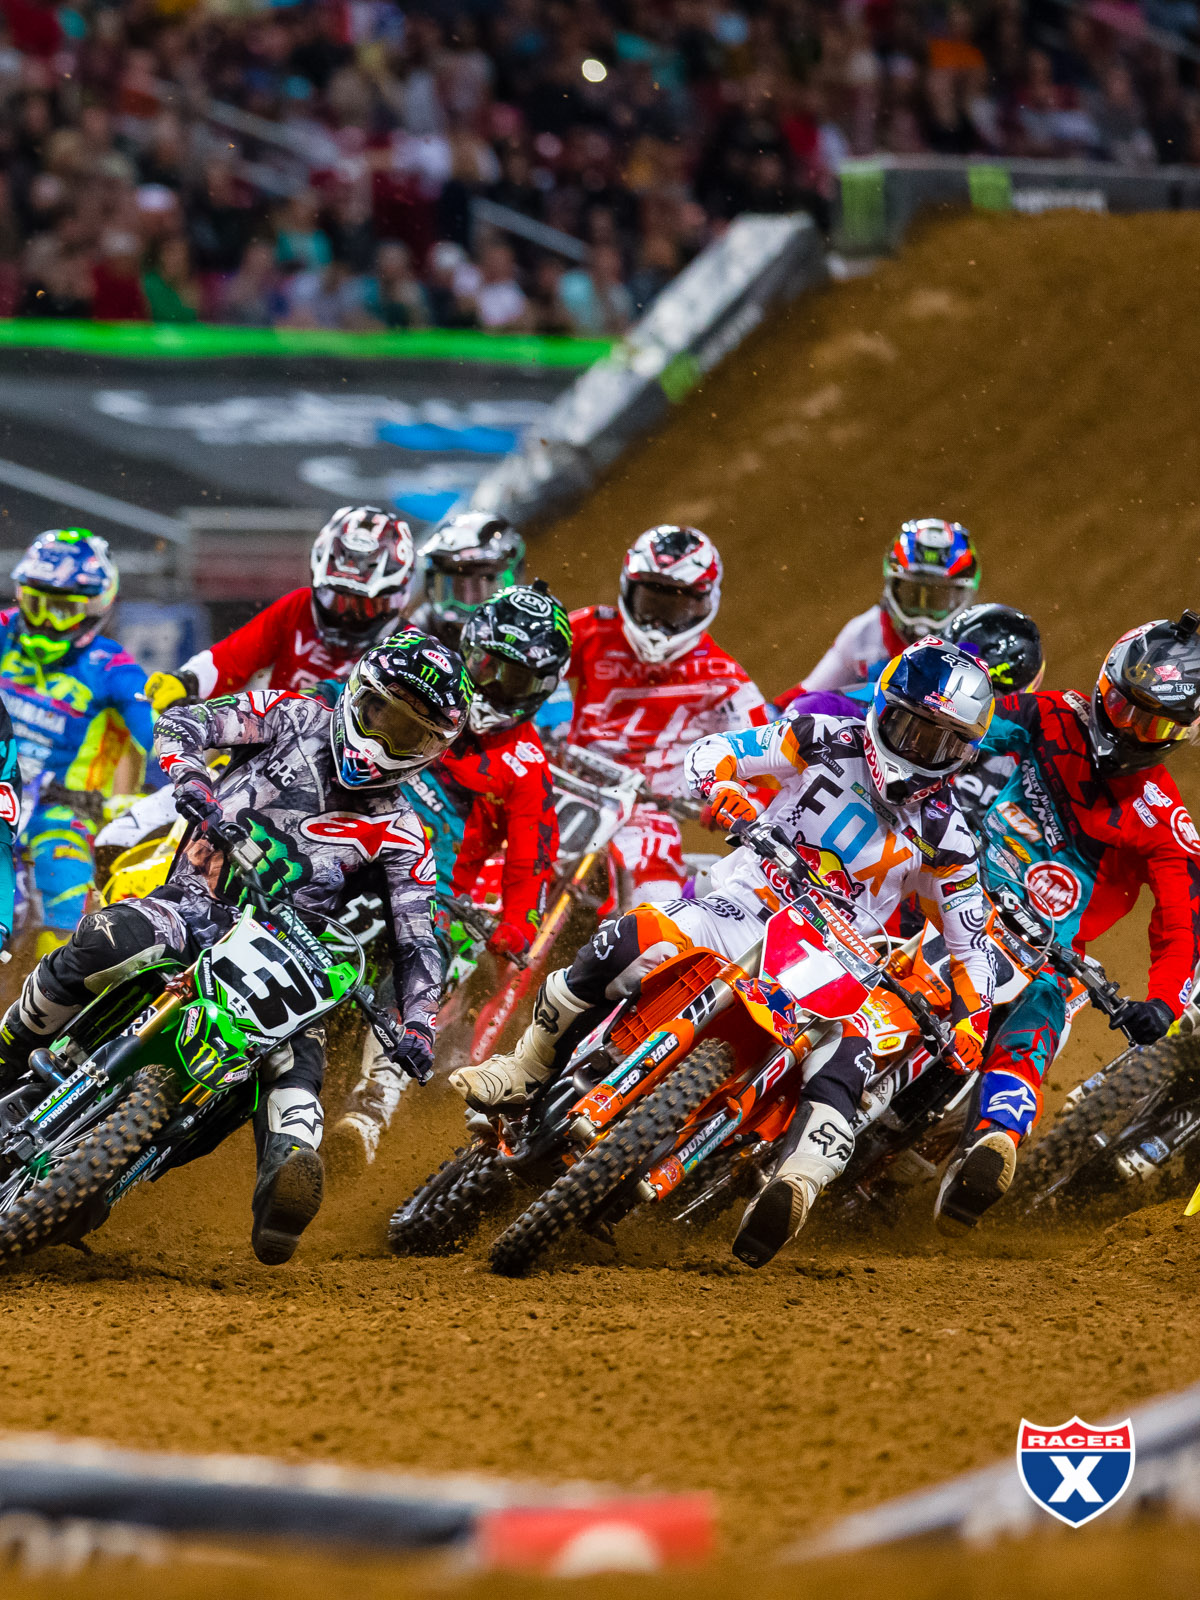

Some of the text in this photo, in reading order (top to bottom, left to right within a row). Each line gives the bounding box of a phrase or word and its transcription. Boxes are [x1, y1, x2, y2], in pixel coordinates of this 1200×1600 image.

[427, 651, 449, 669] BELL
[397, 669, 445, 707] MONSTER
[267, 758, 297, 788] PPG
[996, 800, 1043, 843] KTM
[1028, 766, 1065, 842] ROCKY MOUNTAIN
[798, 774, 914, 898] FOX
[284, 937, 314, 974] MONSTER
[820, 907, 872, 962] RENTHAL
[202, 956, 215, 997] Kawasaki
[212, 937, 318, 1030] 3
[775, 938, 848, 1000] 1
[39, 1093, 80, 1130] CARRILLO
[697, 1119, 740, 1163] MOTOREX
[120, 1145, 158, 1184] CARRILLO
